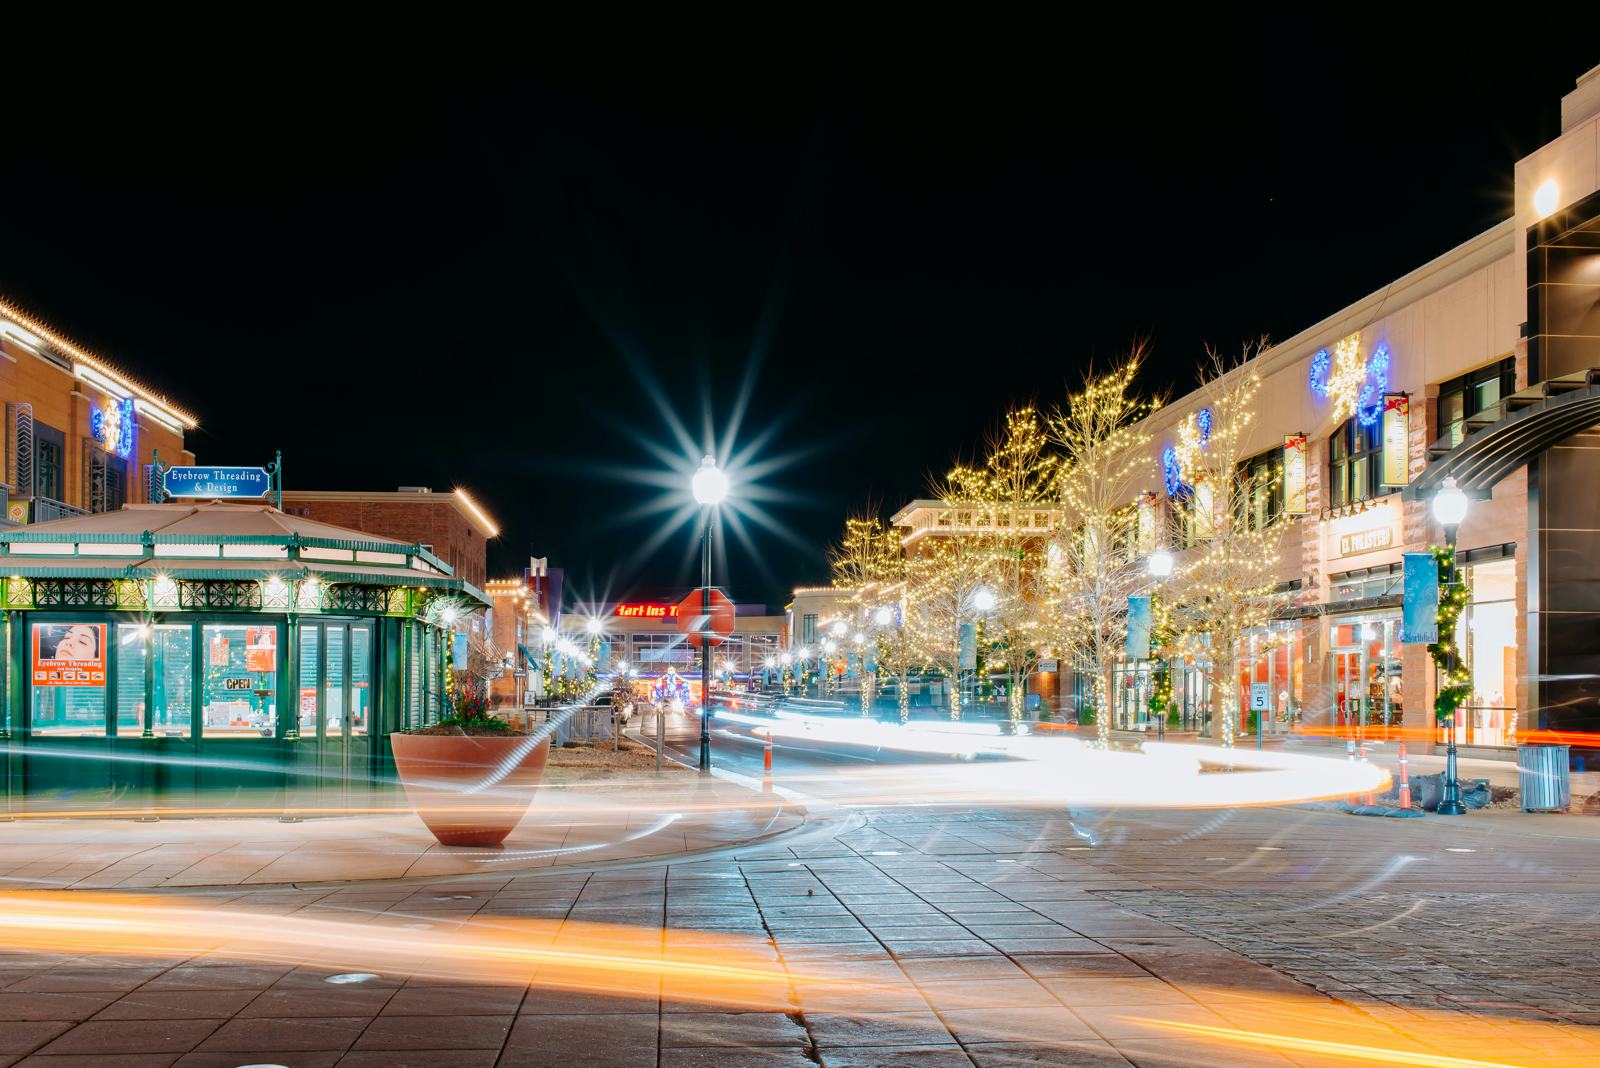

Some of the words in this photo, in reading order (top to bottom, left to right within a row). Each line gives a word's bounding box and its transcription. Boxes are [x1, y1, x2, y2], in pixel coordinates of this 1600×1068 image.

[172, 470, 209, 481] Eyebrow
[213, 470, 261, 482] Threading
[194, 482, 202, 492] &
[207, 482, 238, 493] Design
[1404, 631, 1438, 643] Northfield
[69, 661, 102, 669] Threading
[226, 679, 250, 690] OPEN
[1256, 696, 1264, 707] 5
